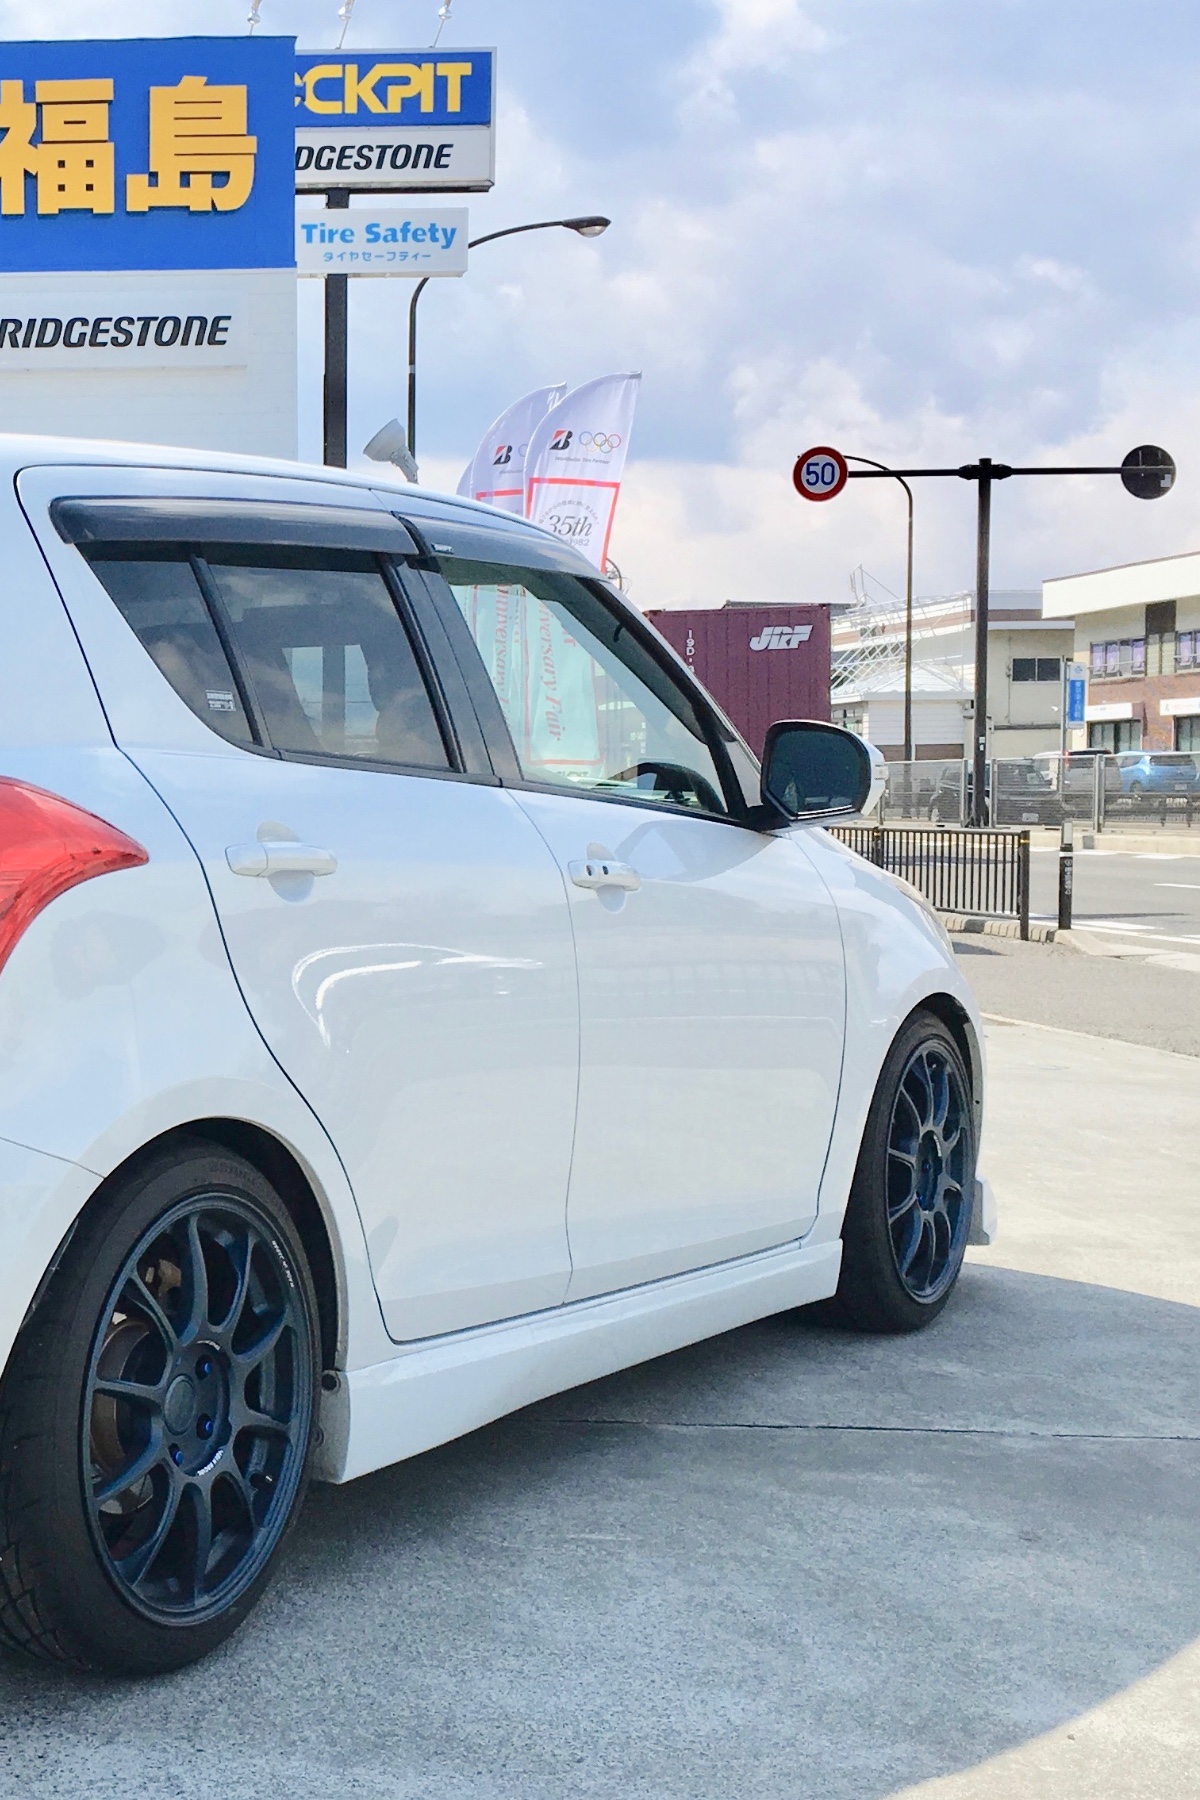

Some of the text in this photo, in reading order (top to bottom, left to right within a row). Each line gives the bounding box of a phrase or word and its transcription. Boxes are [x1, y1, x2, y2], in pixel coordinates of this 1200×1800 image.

[294, 62, 473, 115] CKPIT
[295, 143, 454, 172] DGESTONE
[301, 221, 457, 250] Tire Safety
[323, 251, 432, 262] タイヤセーフティー
[805, 462, 835, 486] 50
[549, 514, 593, 537] 35th
[749, 624, 813, 652] JRF
